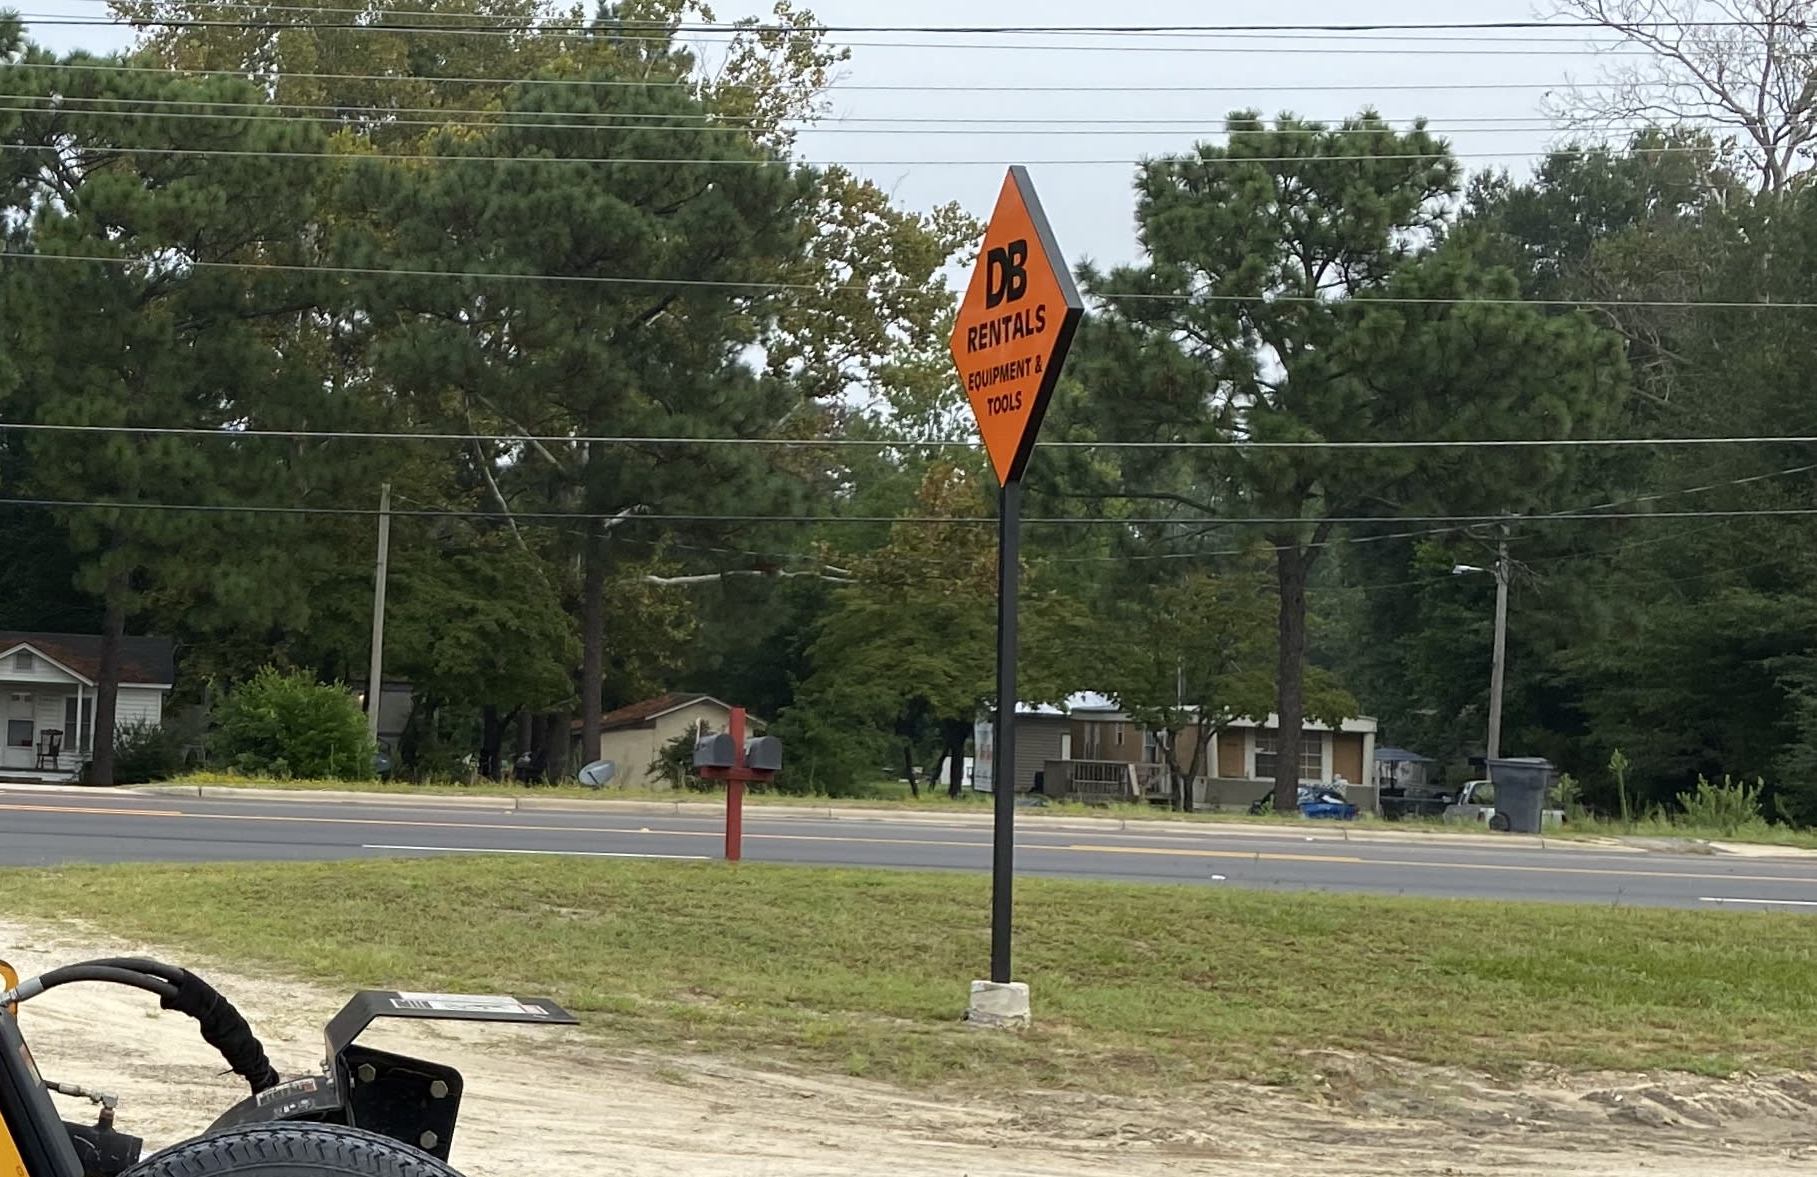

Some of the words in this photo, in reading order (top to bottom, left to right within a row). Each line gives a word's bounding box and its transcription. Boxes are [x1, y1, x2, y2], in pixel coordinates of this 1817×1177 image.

[986, 239, 1028, 310] DB
[967, 304, 1046, 353] RENTALS
[968, 357, 1031, 391] EQUIPMENT
[1034, 355, 1043, 374] &
[987, 391, 1022, 416] TOOLS
